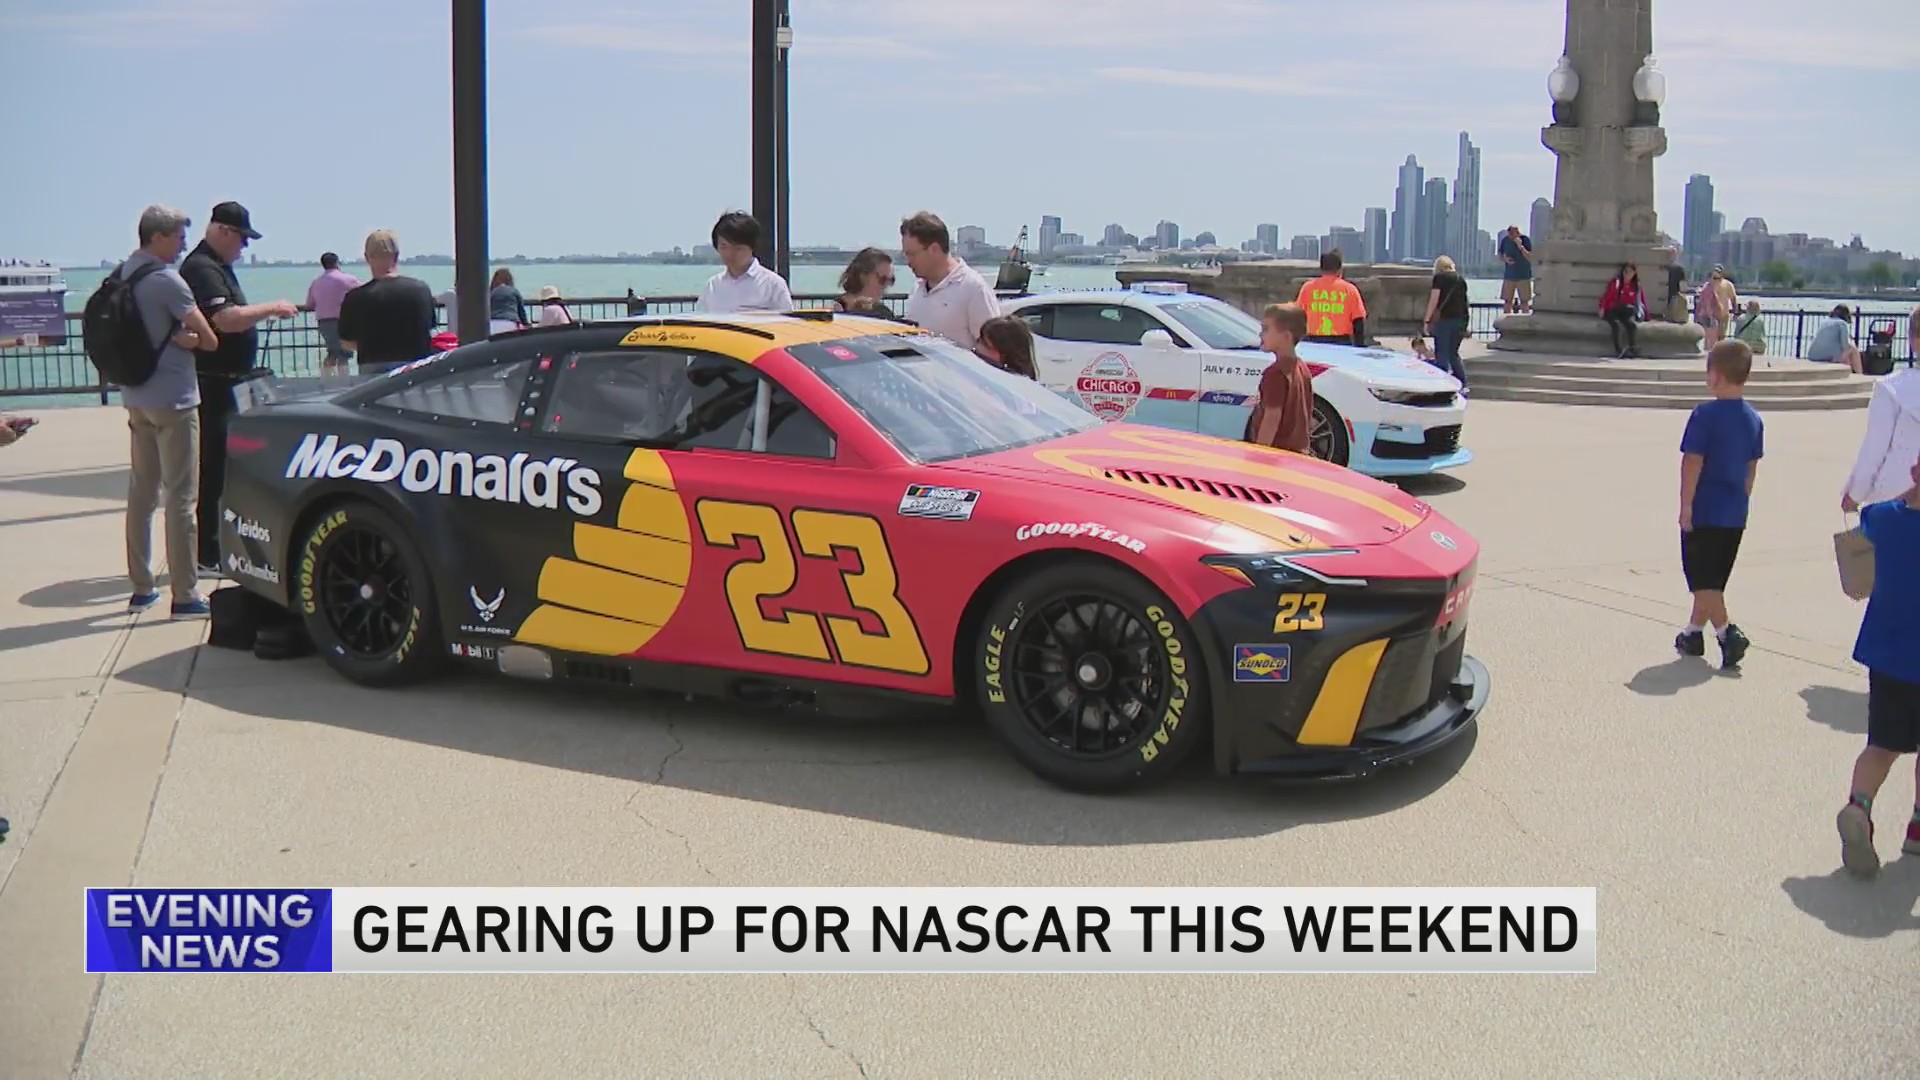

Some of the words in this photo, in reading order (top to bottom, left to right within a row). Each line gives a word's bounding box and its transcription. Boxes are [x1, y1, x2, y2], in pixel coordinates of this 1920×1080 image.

[1311, 302, 1345, 314] RIDER
[1312, 289, 1347, 302] EASY
[1203, 365, 1225, 374] JULY
[1082, 379, 1136, 393] CHICAGO
[286, 432, 602, 516] McDonald's
[237, 515, 271, 542] leidos
[1016, 522, 1147, 554] GOODYEAR
[237, 556, 280, 584] Columbia
[301, 510, 348, 614] GOODYEAR
[695, 496, 931, 677] 23
[1273, 593, 1327, 634] 23
[451, 643, 482, 658] Mobil
[984, 624, 1006, 702] EAGLE
[1238, 658, 1286, 669] SUNOCO
[1140, 605, 1190, 762] GOODYEAR
